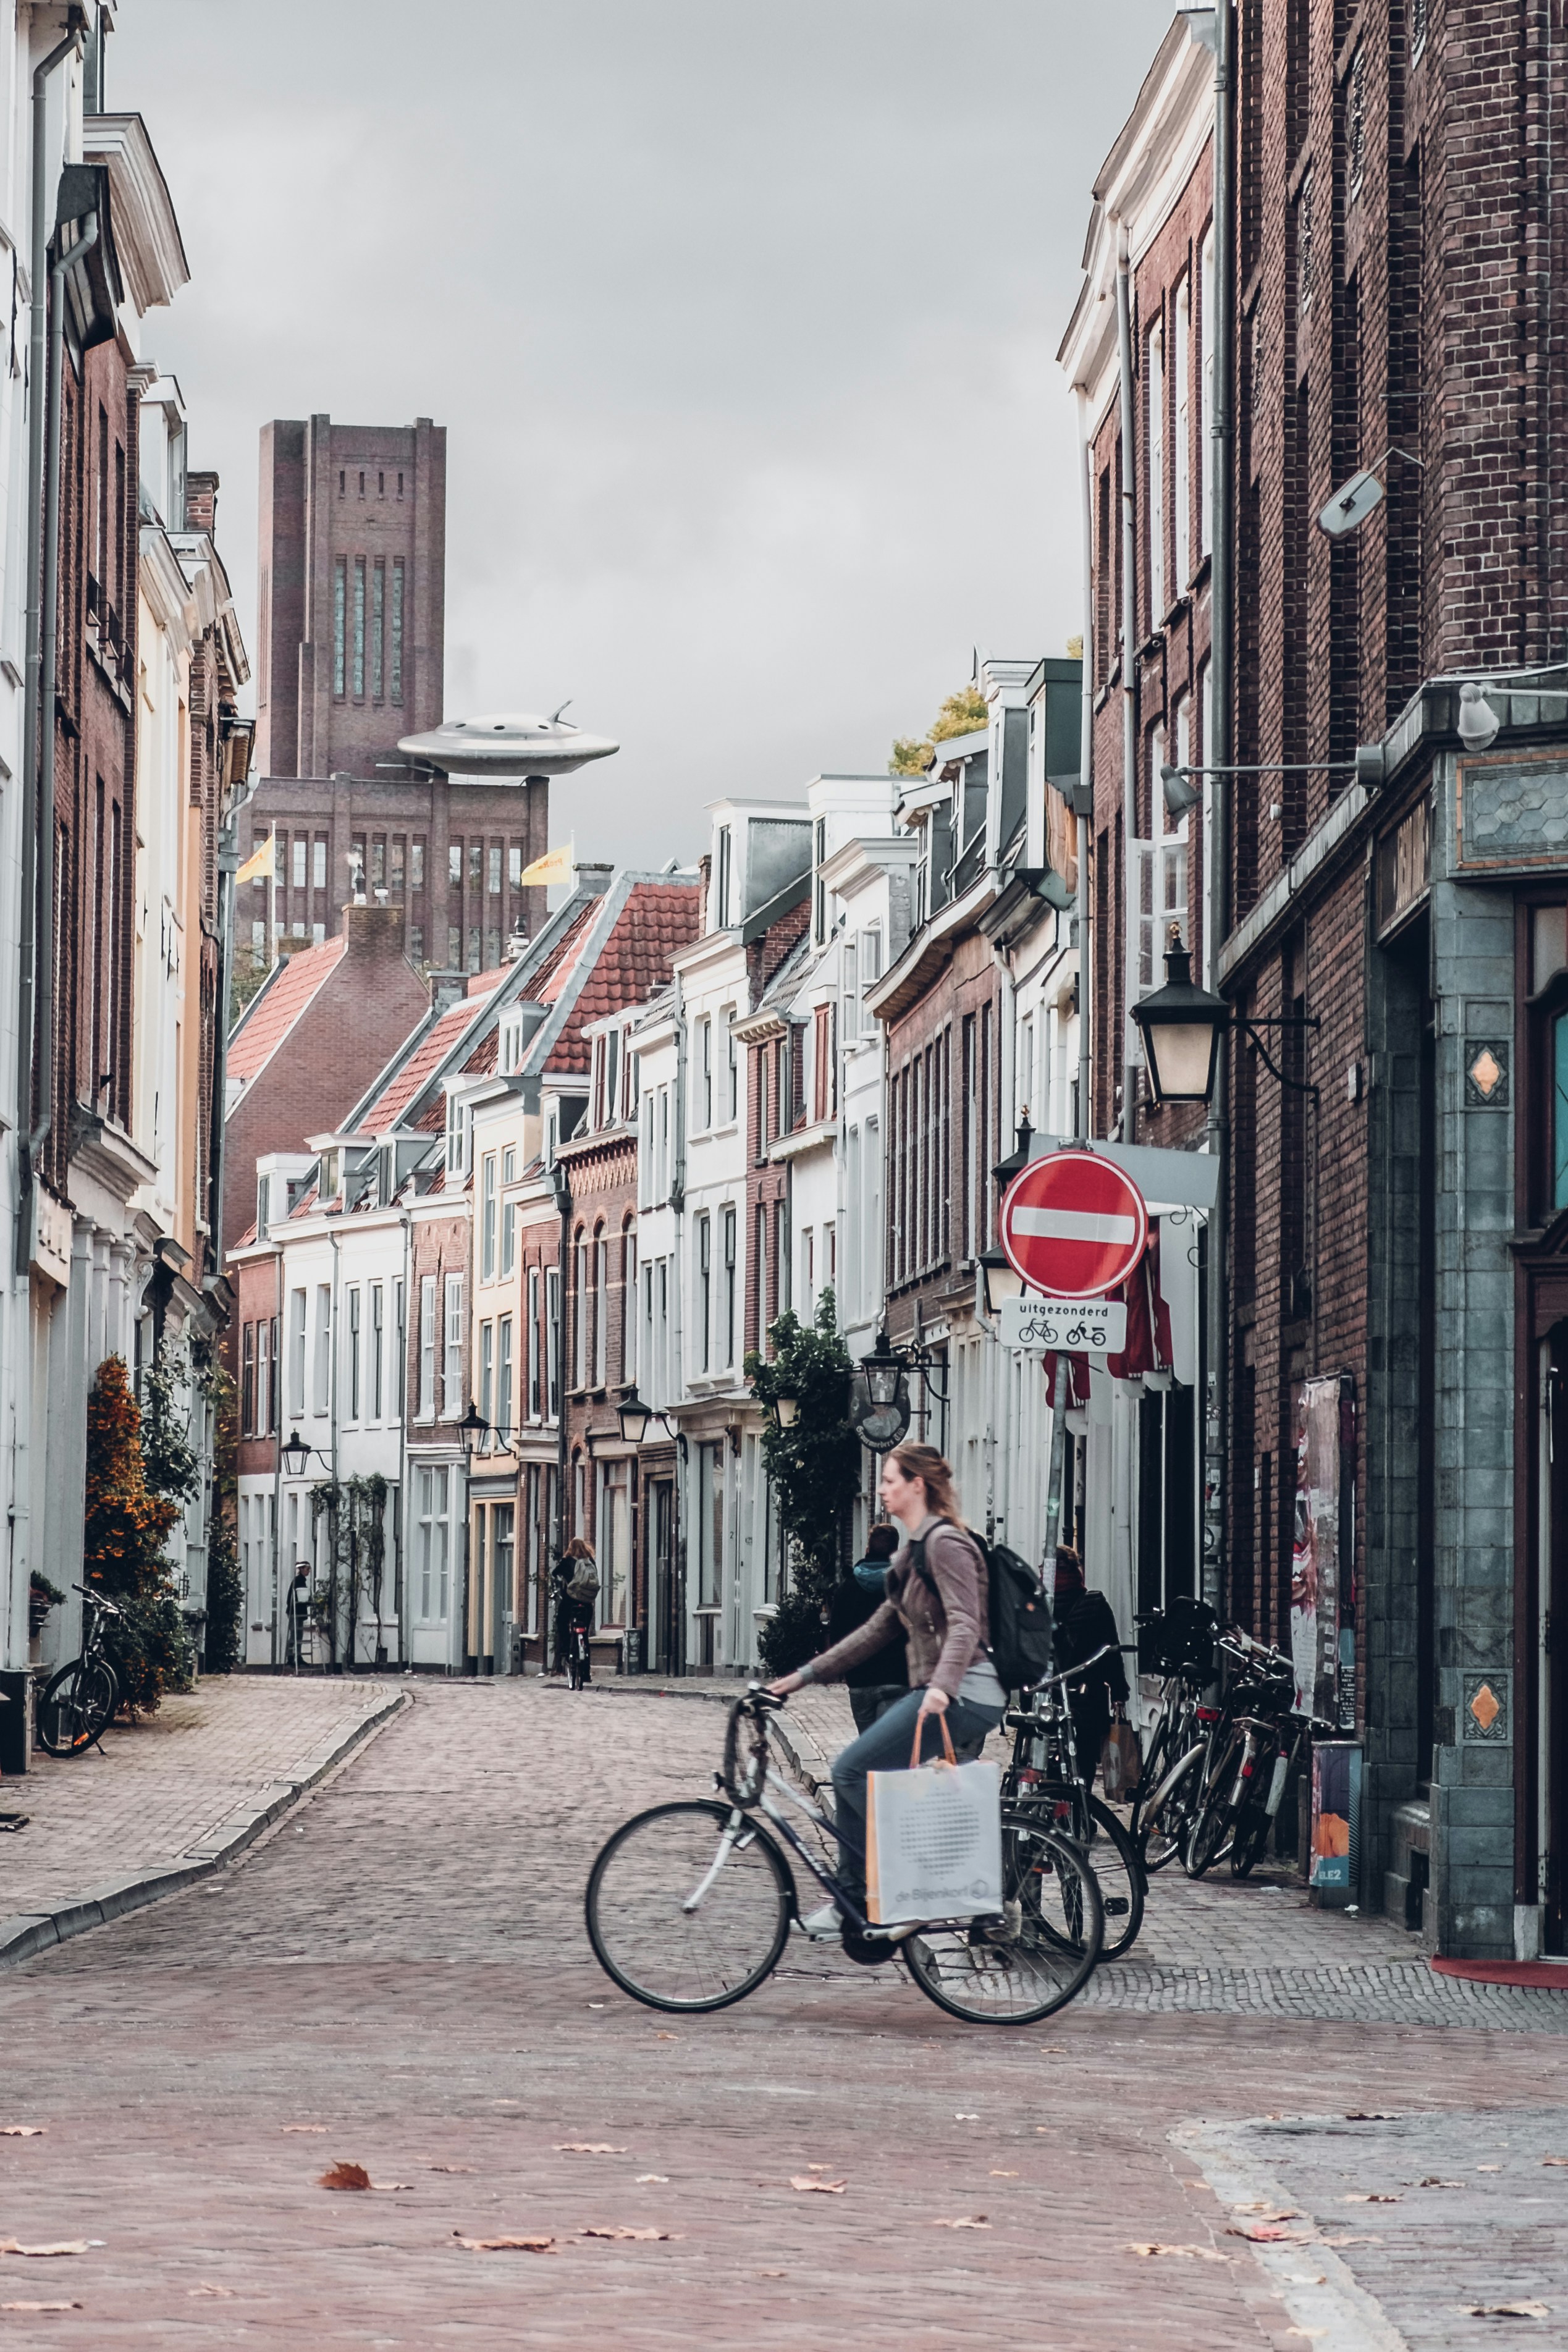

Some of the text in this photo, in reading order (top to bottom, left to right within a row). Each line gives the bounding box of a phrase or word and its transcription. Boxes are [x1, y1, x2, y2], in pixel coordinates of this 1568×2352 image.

[1020, 1304, 1108, 1317] uitgezonderd
[730, 1531, 734, 1539] 2
[1318, 1869, 1341, 1880] ELE2
[895, 1886, 968, 1902] de Bijenkorf
